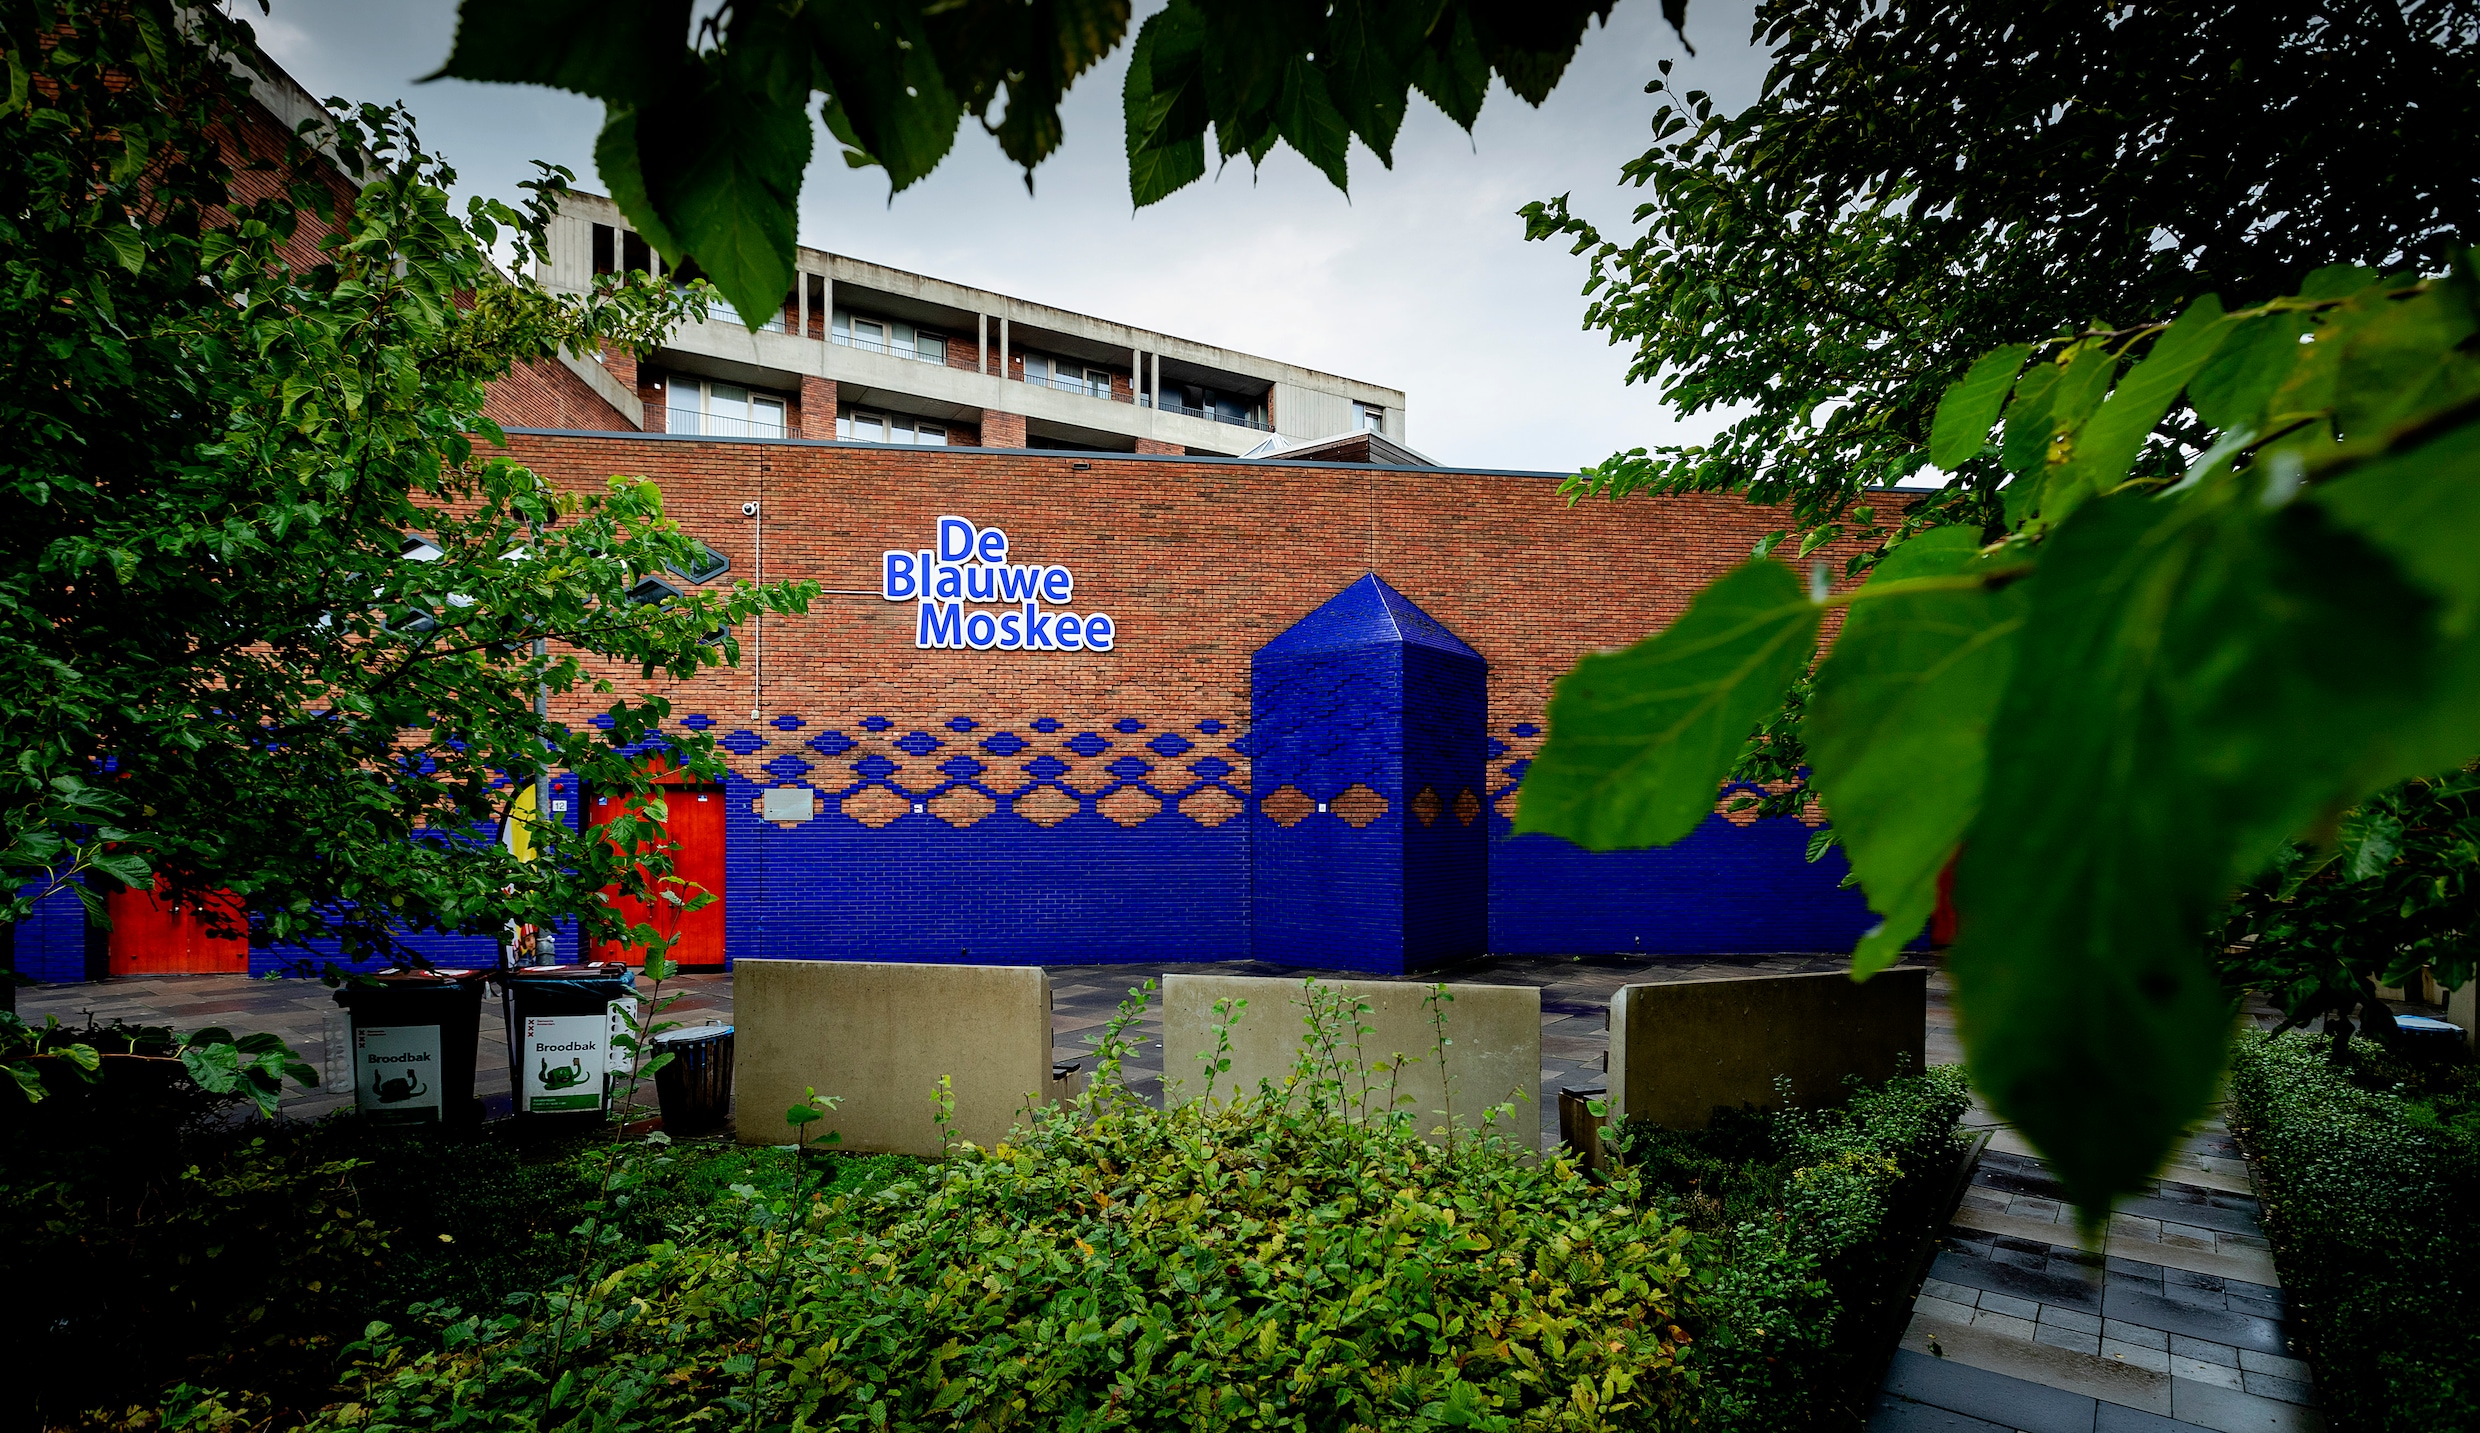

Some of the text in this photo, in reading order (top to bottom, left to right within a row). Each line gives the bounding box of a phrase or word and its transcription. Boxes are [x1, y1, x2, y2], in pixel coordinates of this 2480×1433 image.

[941, 519, 1005, 563] De
[887, 553, 1070, 600] Blauwe
[920, 603, 1111, 647] Moskee
[555, 802, 565, 810] 12
[368, 1052, 431, 1064] Broodbak
[536, 1041, 596, 1052] Broodbak
